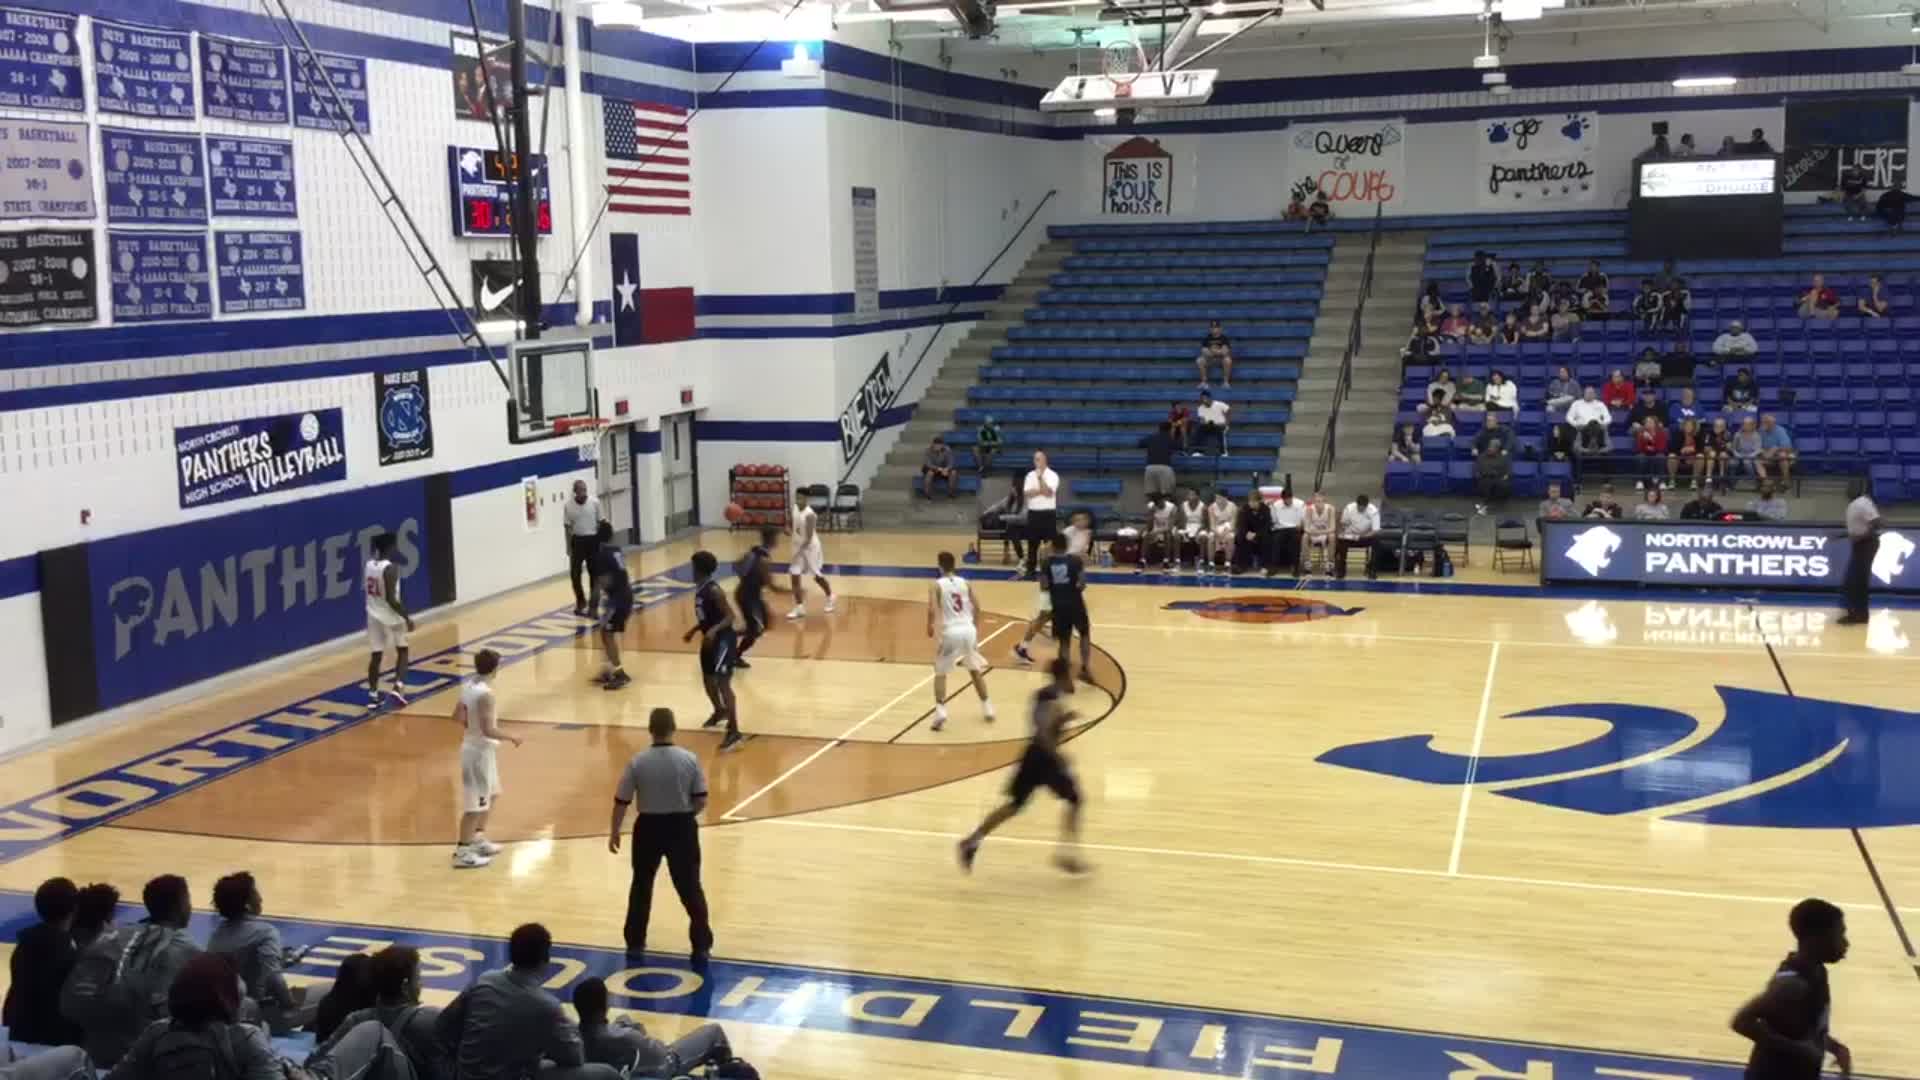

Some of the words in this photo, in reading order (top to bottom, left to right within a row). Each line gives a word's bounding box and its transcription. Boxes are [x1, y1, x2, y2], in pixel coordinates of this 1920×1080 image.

[1512, 116, 1543, 150] go
[1109, 160, 1138, 183] THIS
[1146, 160, 1163, 181] IS
[1489, 159, 1594, 195] panthers
[3, 200, 32, 213] STATE
[180, 431, 273, 487] PANTHERS
[245, 436, 344, 493] VOLLEYBALL
[209, 473, 246, 496] SCHOOL
[1645, 532, 1714, 550] NORTH
[1721, 533, 1828, 551] CROWLEY
[1645, 551, 1830, 578] PANTHERS
[951, 592, 964, 613] 3
